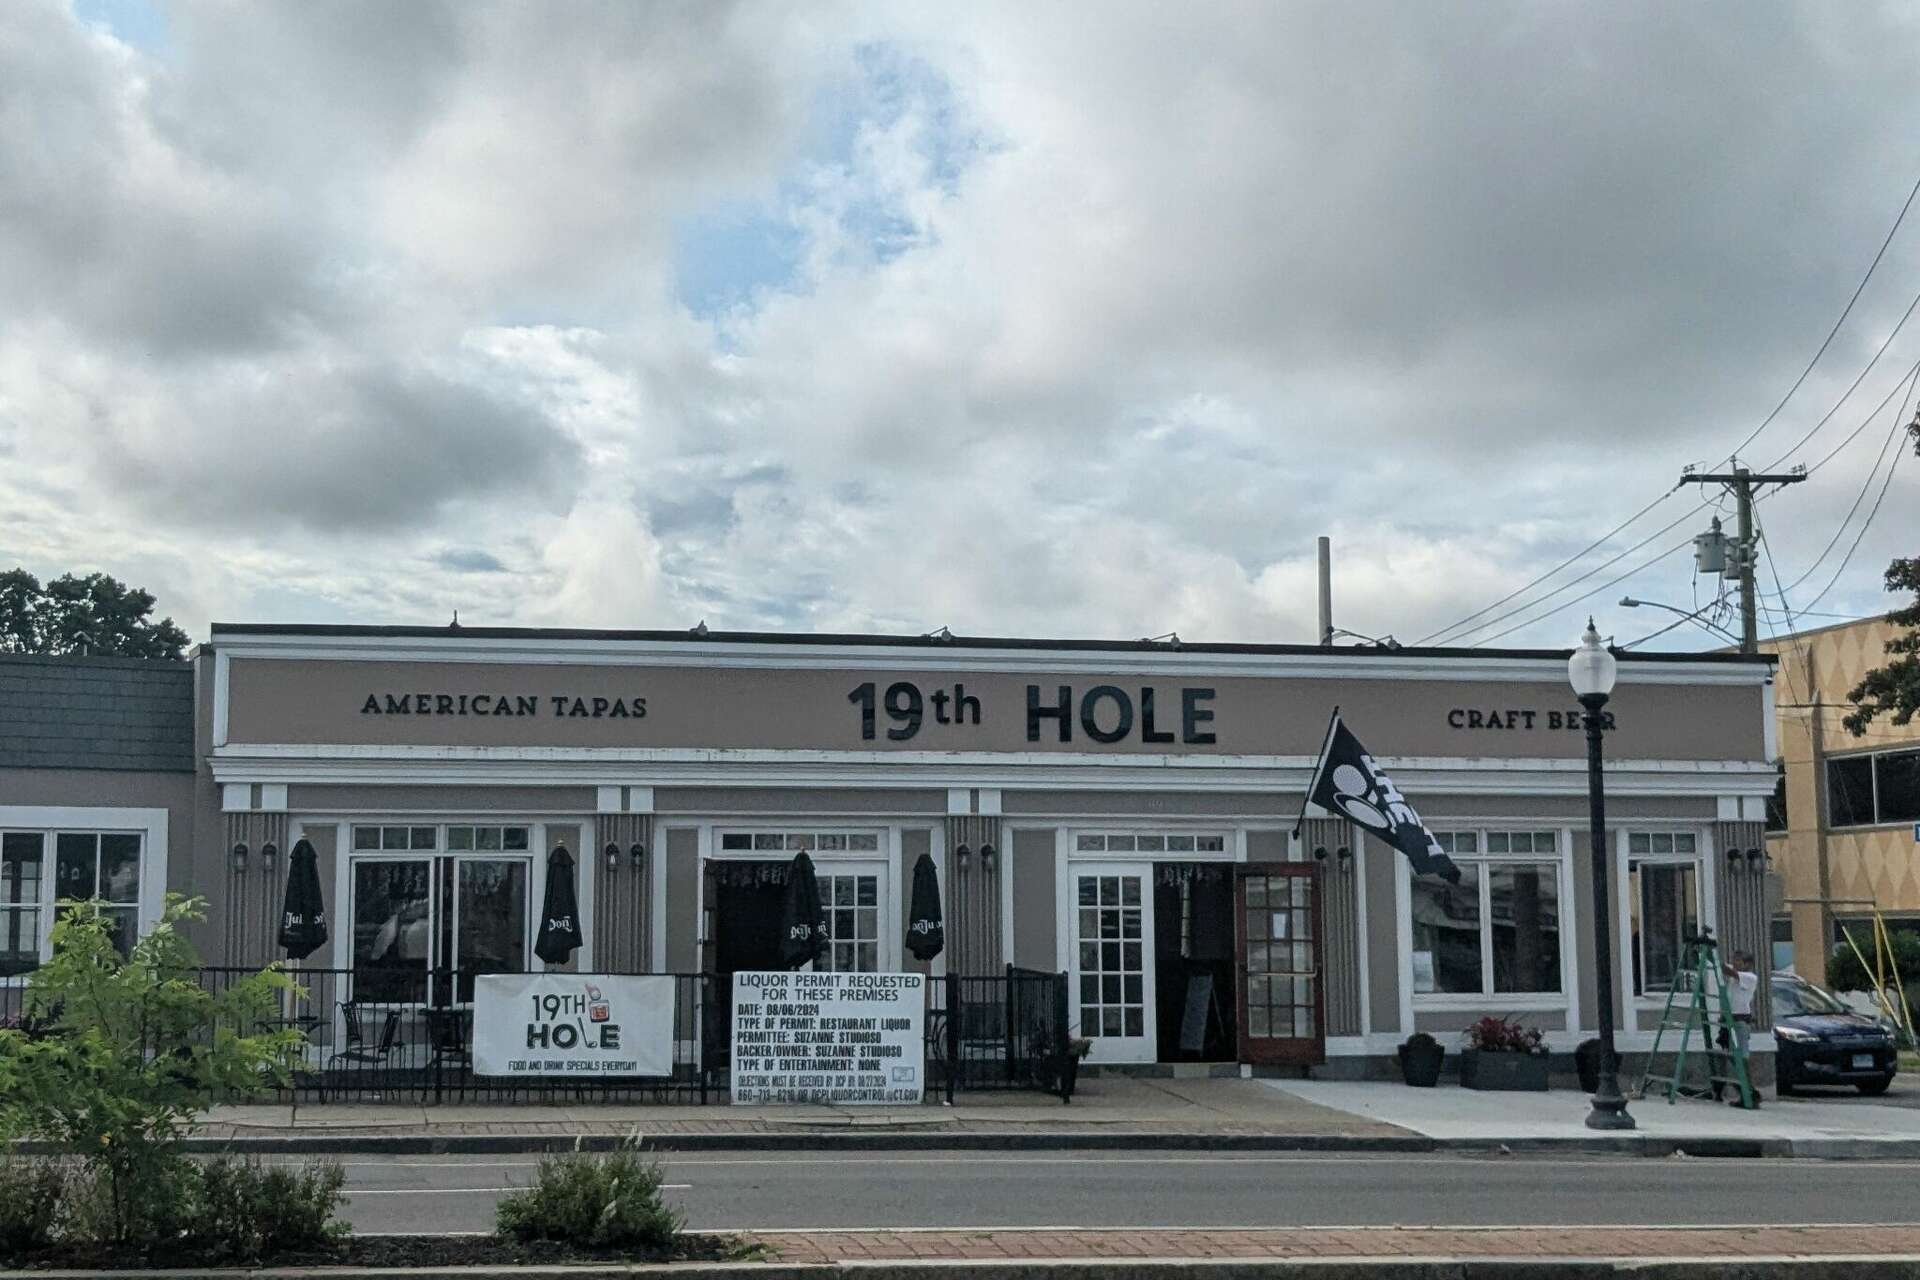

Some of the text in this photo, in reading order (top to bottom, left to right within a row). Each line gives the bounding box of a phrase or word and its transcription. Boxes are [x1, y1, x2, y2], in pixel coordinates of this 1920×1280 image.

[360, 693, 647, 718] AMERICAN TAPAS
[847, 681, 1216, 744] 19th HOLE
[1448, 709, 1616, 731] CRAFT BER
[740, 974, 921, 989] LIQUOR PERMIT REQUESTED
[762, 988, 898, 1001] FOR THESE PREMISES
[532, 994, 586, 1022] 19TH
[738, 1003, 762, 1015] DATE:
[738, 1018, 911, 1031] TYPE OF PERMIT: RESTAURANT LIQUOR
[737, 1031, 881, 1043] PERMITTEE: SUZANNE STUDIOSO
[737, 1045, 811, 1057] BACKER/OWNER:
[815, 1045, 855, 1057] SUZANNE
[508, 1060, 527, 1071] FOOD
[528, 1060, 542, 1071] AND
[544, 1060, 565, 1071] DRINK
[566, 1060, 600, 1071] SPECIALS
[737, 1059, 881, 1071] TYPE OF ENTERTAINMENT: NONE
